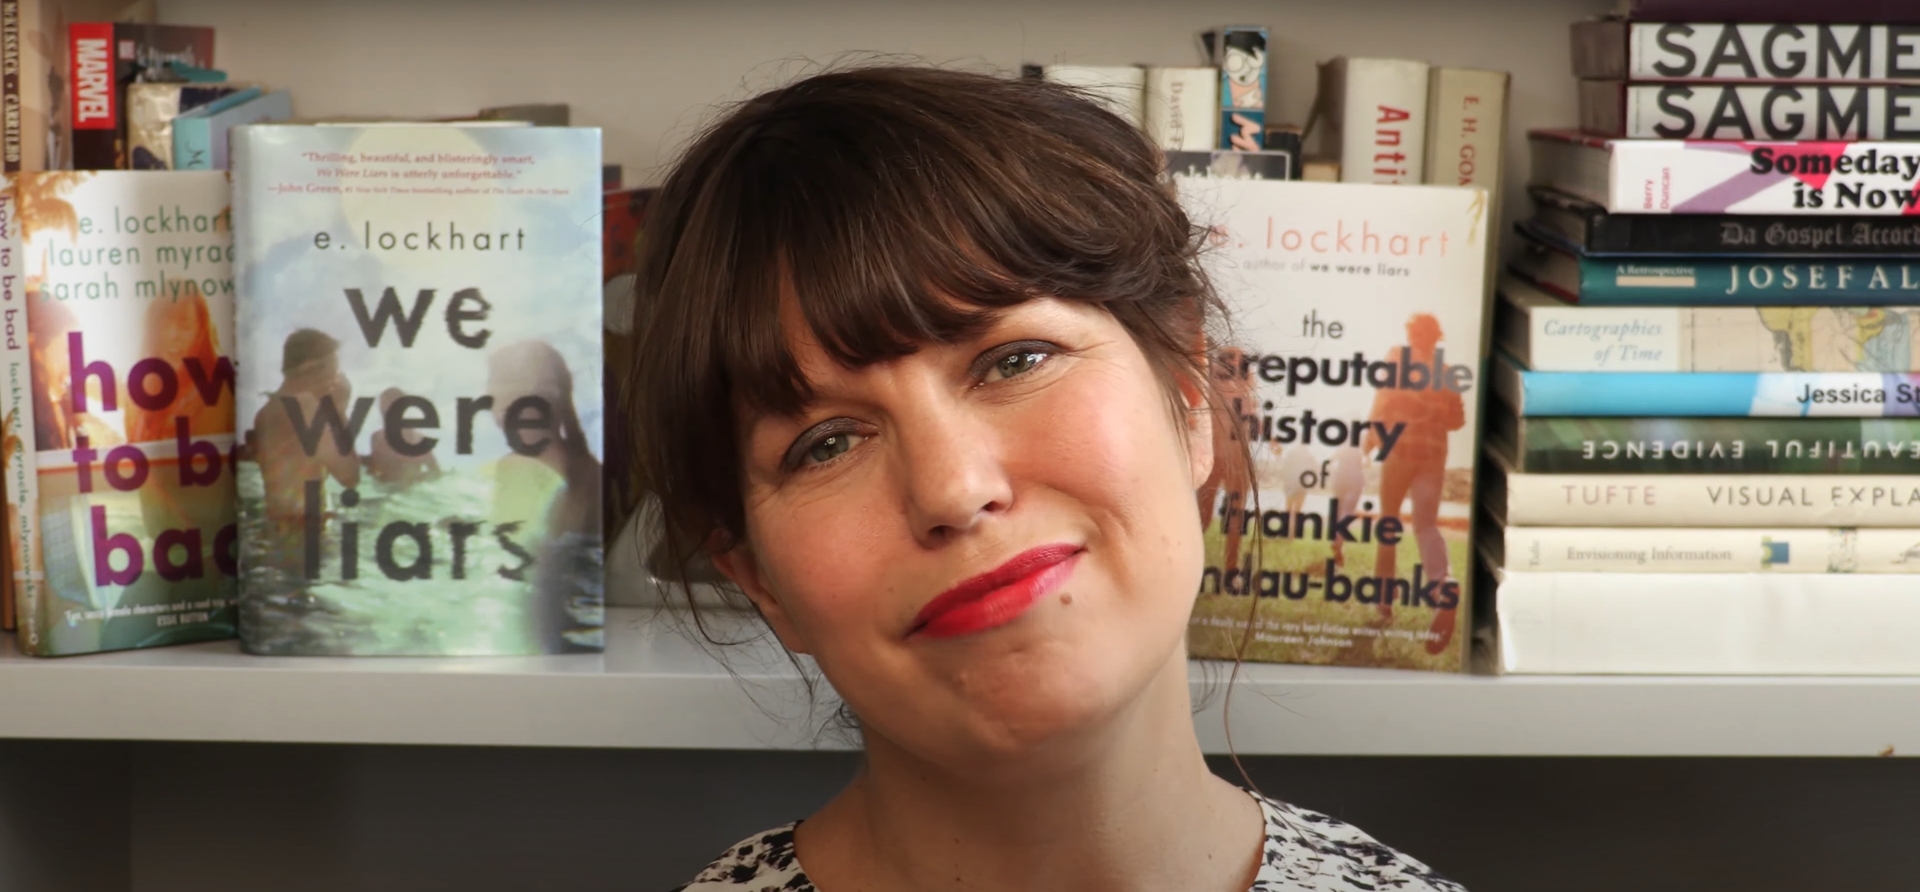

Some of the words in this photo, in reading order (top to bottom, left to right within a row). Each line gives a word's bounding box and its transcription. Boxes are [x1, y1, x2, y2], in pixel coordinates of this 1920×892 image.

[1652, 23, 1920, 79] SAGME
[76, 38, 110, 123] MARVEL
[1463, 95, 1480, 111] E.
[1652, 85, 1920, 139] SAGME
[1461, 118, 1478, 139] H.
[359, 152, 412, 164] beautiful,
[414, 153, 435, 164] and
[437, 153, 499, 166] blisteringly
[501, 154, 535, 165] smart,
[1373, 105, 1410, 184] Anti
[390, 169, 400, 178] is
[402, 168, 439, 181] utterly
[1750, 147, 1920, 182] Someday
[1643, 178, 1655, 210] Berry
[1659, 166, 1671, 210] Duncan
[1793, 182, 1824, 209] is
[1834, 182, 1920, 210] Now
[0, 194, 12, 240] how
[78, 217, 104, 235] e.
[114, 205, 233, 235] lockhart
[313, 230, 346, 251] e.
[364, 220, 526, 251] lockhart
[1207, 223, 1244, 249] e.
[1265, 215, 1450, 258] lockhart
[1720, 222, 1757, 246] Da
[1764, 222, 1843, 249] Gospel
[1, 248, 12, 268] to
[48, 237, 141, 267] lauren
[1242, 257, 1286, 271] author
[1292, 257, 1304, 271] of
[1309, 262, 1330, 273] we
[1336, 264, 1371, 276] were
[1377, 262, 1410, 277] liars
[38, 271, 119, 301] sarah
[1616, 264, 1625, 275] A
[1627, 264, 1695, 278] Retrospective
[1725, 265, 1853, 294] JOSEF
[2, 275, 17, 302] be
[4, 308, 21, 351] bad
[342, 285, 494, 350] we
[1302, 309, 1344, 340] the
[1543, 318, 1663, 345] Cartographies
[1594, 343, 1611, 363] of
[1618, 343, 1663, 362] Time
[67, 331, 237, 414] how
[1212, 345, 1474, 397] sreputable
[1797, 383, 1888, 405] Jessica
[279, 394, 552, 457] were
[1230, 397, 1407, 462] history
[72, 435, 150, 494] to
[175, 416, 238, 487] b
[1582, 440, 1745, 460] EVIDENCE
[1298, 459, 1332, 490] of
[1561, 485, 1657, 506] TUFTE
[1707, 486, 1813, 507] VISUAL
[303, 479, 535, 582] liars
[1218, 490, 1405, 546] frankie
[1566, 546, 1647, 565] Envisioning
[1651, 546, 1733, 562] Information
[1199, 551, 1461, 611] ndau-banks
[1254, 631, 1304, 643] Maureen
[1306, 633, 1354, 648] Johnson
